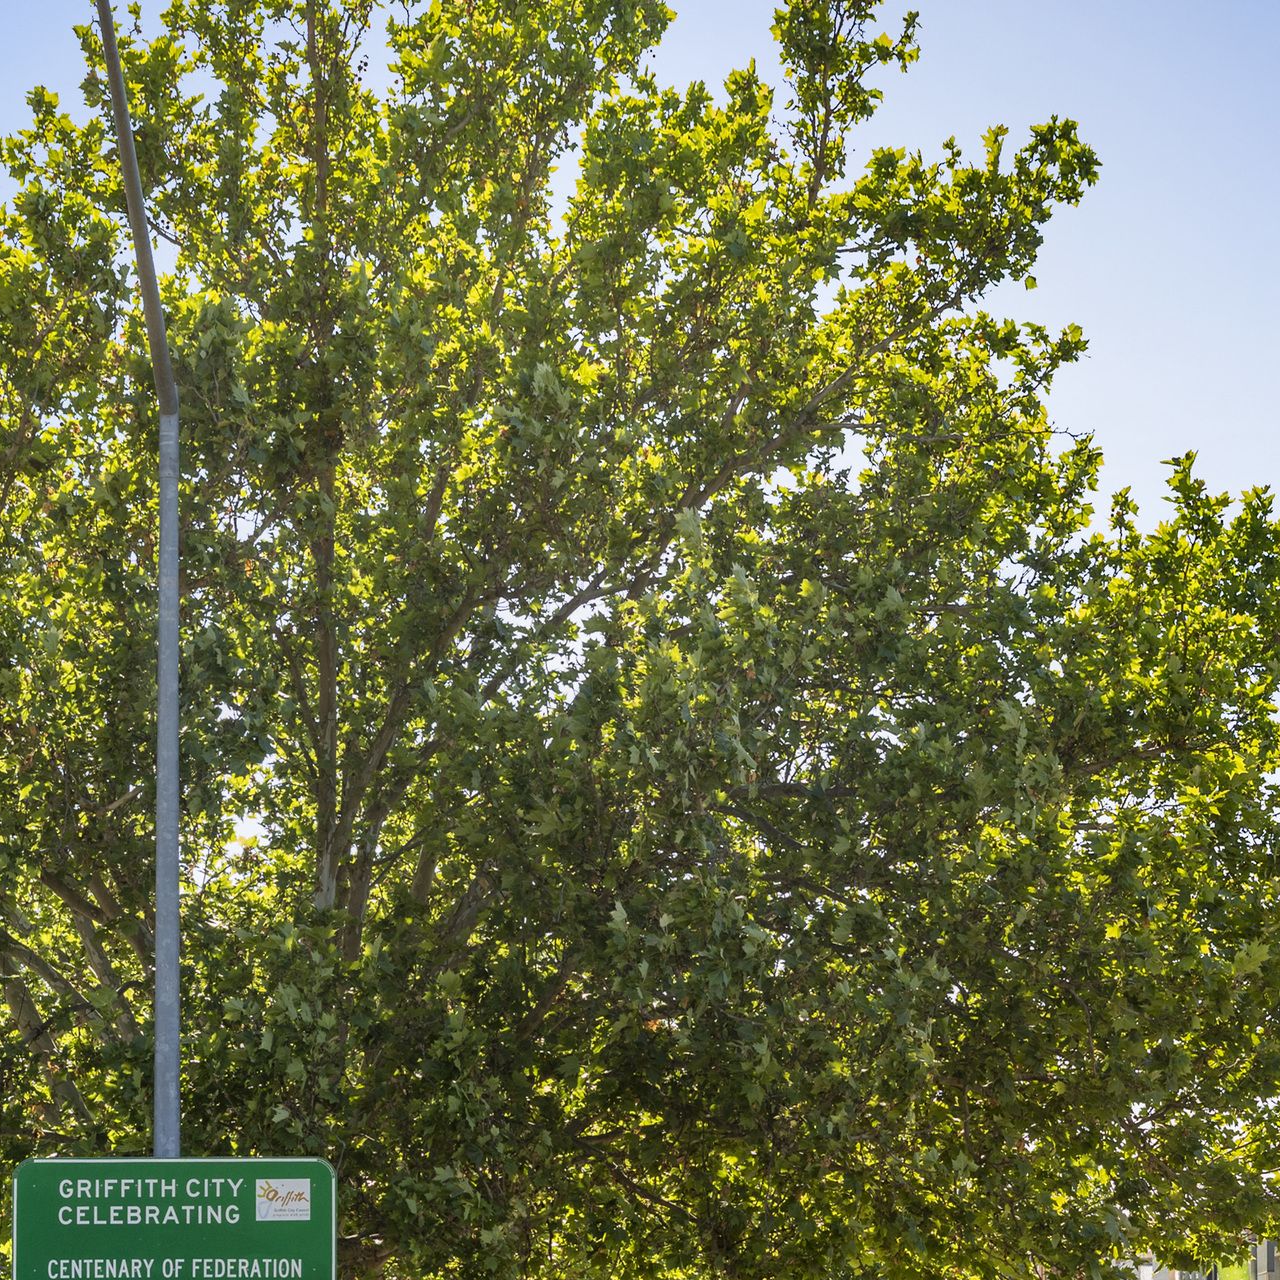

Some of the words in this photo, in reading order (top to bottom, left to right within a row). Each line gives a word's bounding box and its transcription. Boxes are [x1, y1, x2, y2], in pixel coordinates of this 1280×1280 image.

[59, 1179, 176, 1198] GRIFFITH
[186, 1178, 244, 1198] CITY
[58, 1205, 240, 1225] CELEBRATING
[48, 1259, 154, 1279] CENTENARY
[162, 1258, 185, 1278] OF
[192, 1258, 302, 1278] FEDERATION
